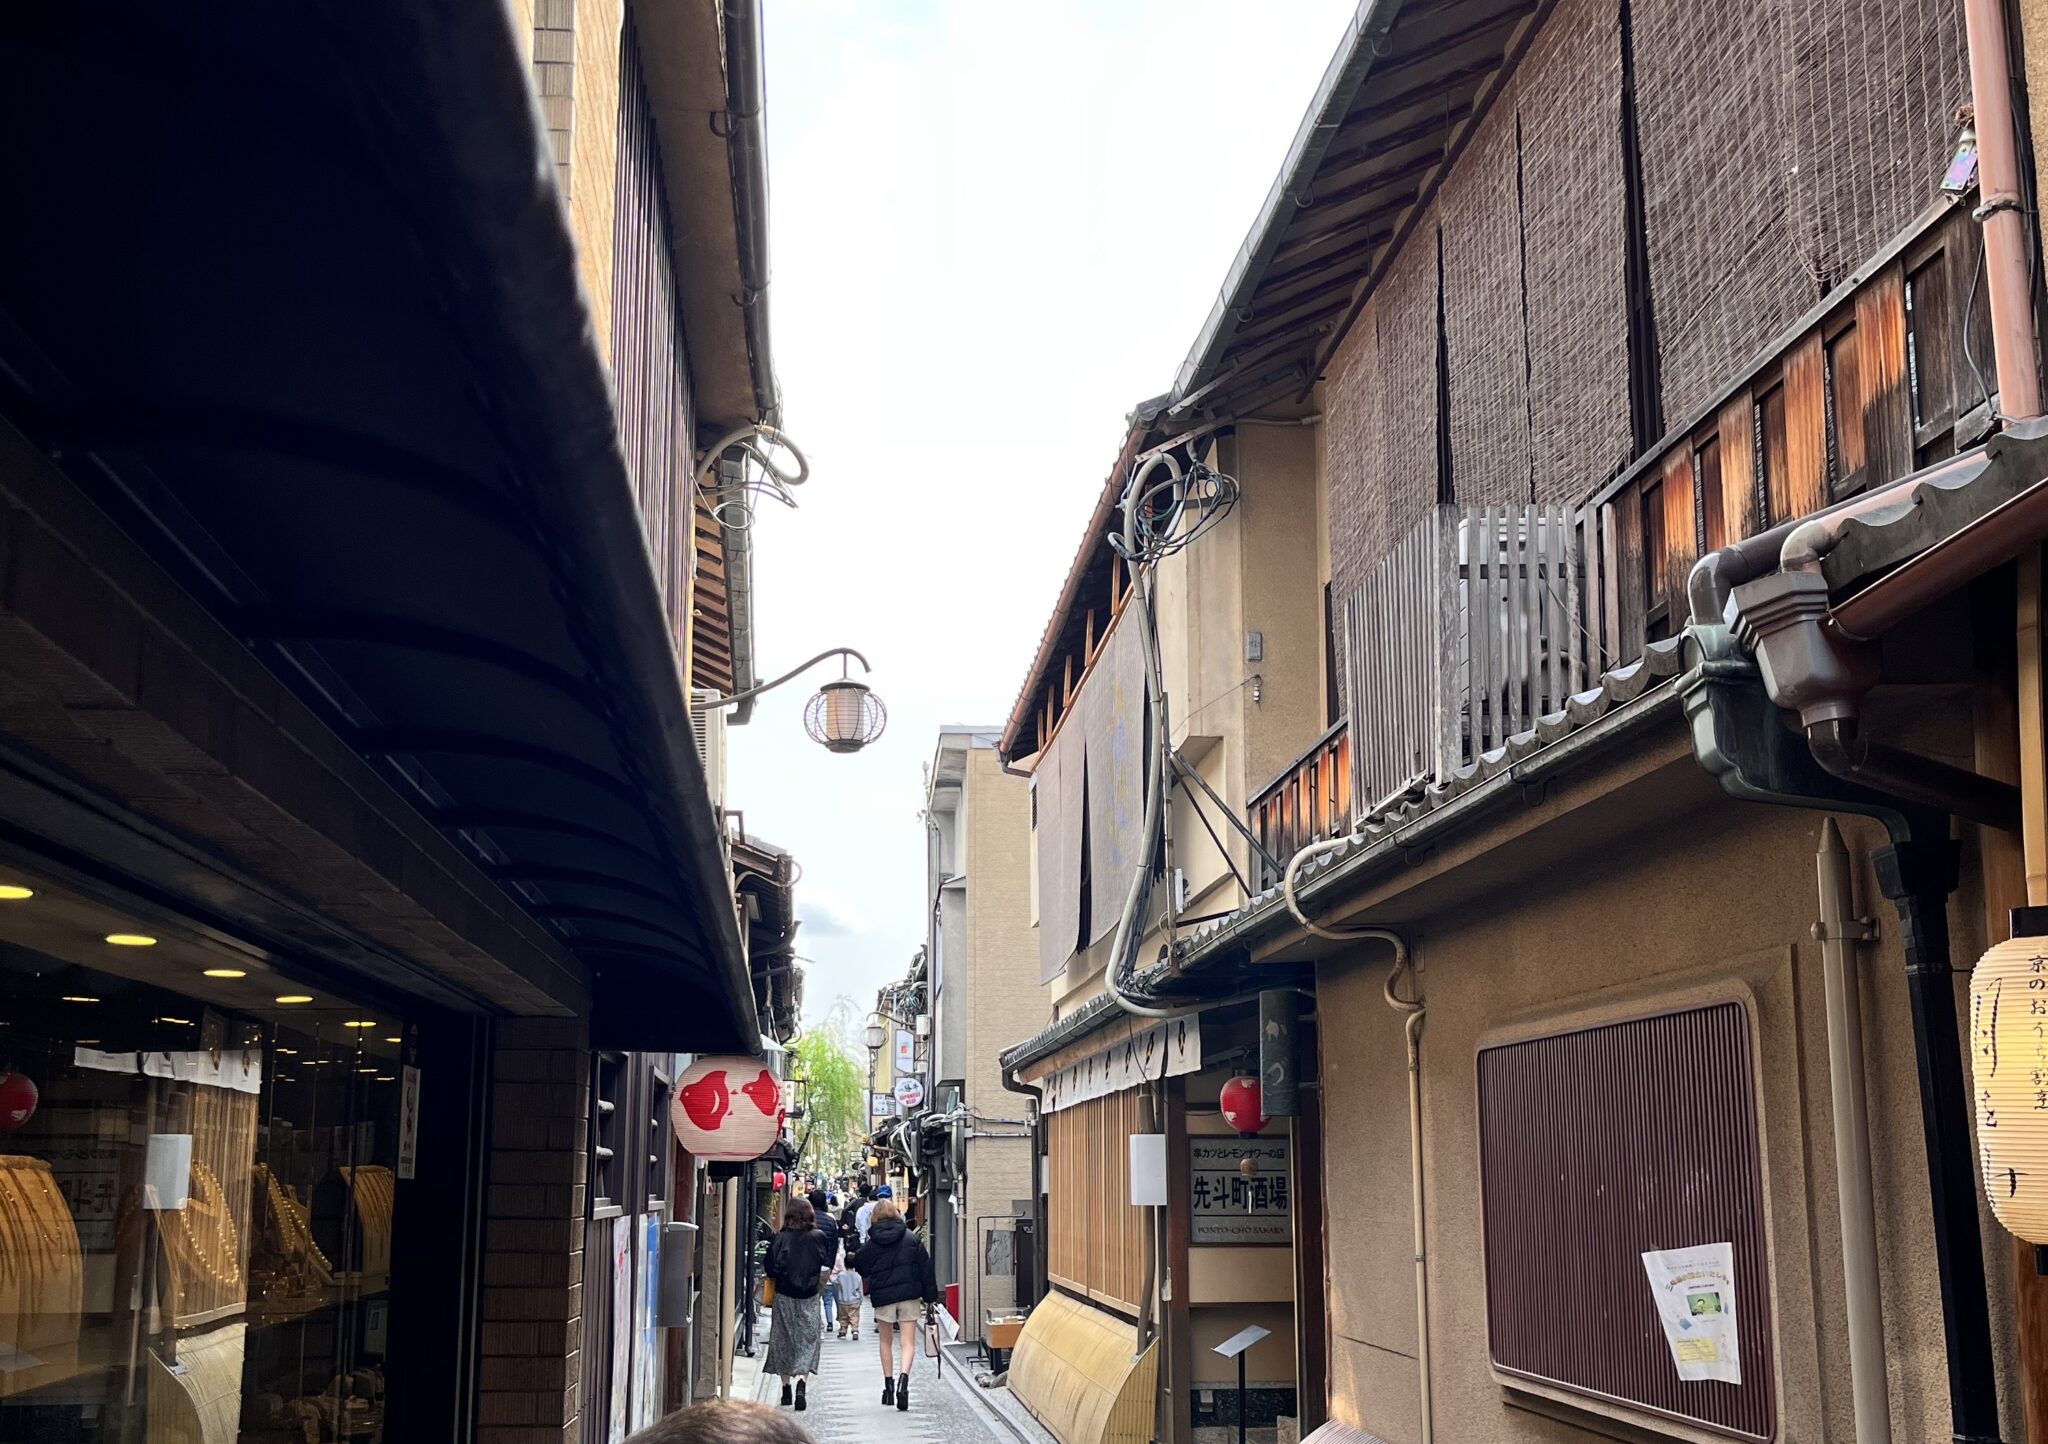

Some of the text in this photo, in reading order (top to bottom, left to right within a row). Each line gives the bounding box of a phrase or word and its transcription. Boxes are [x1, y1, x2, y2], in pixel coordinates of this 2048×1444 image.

[1193, 1176, 1288, 1210] 先斗町酒場
